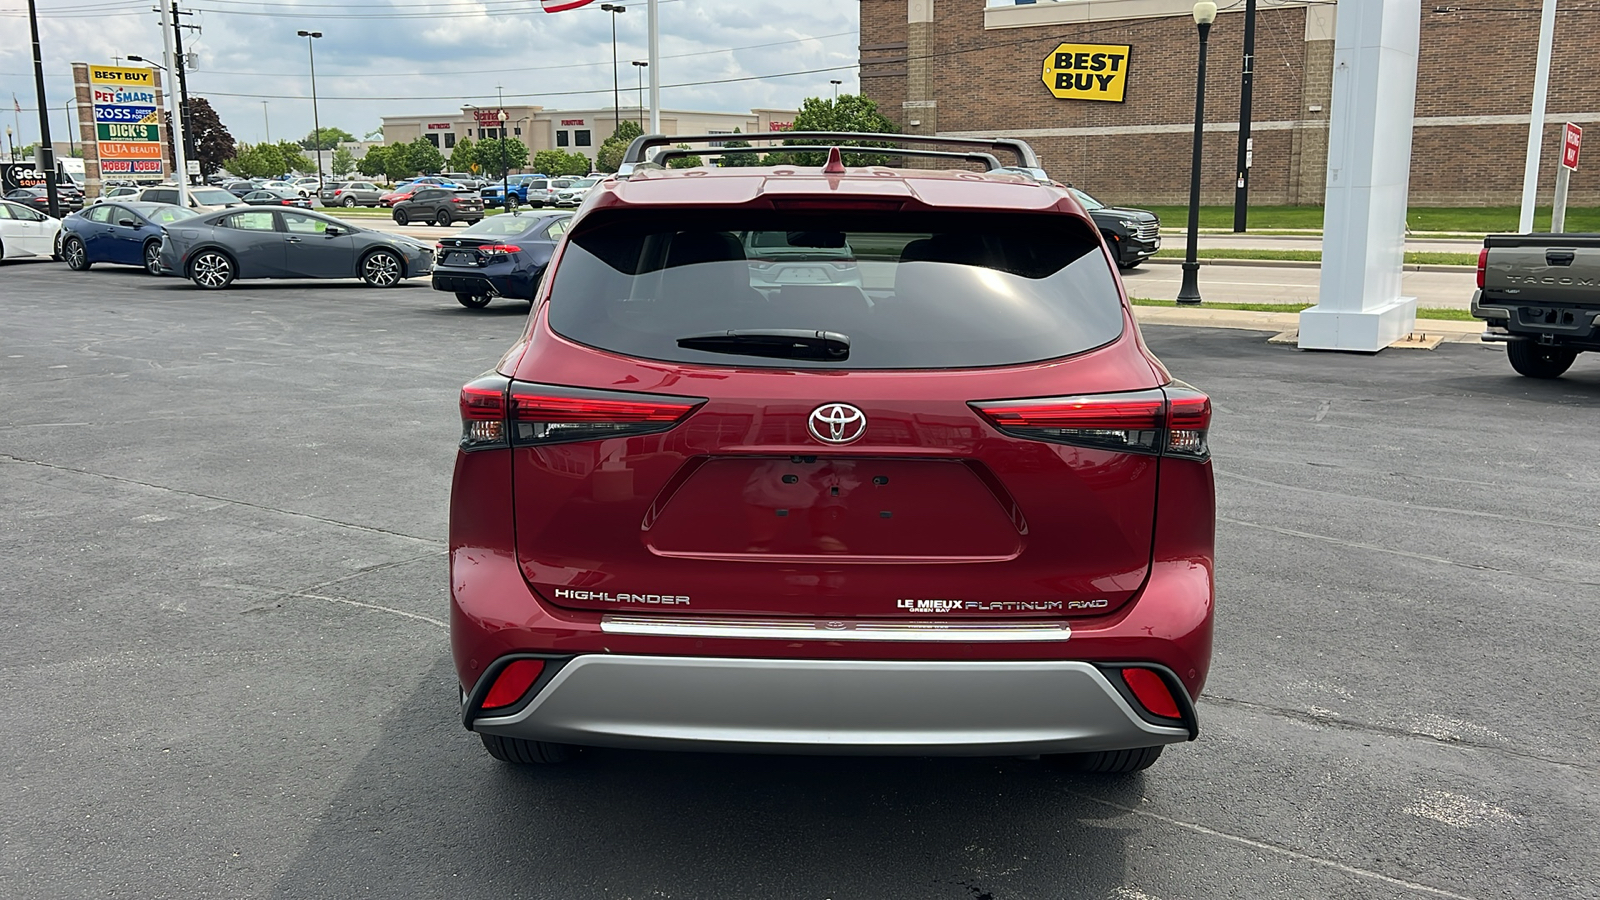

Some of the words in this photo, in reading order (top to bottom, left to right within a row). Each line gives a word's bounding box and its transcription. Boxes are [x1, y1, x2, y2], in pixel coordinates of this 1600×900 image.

[1054, 52, 1124, 72] BEST
[94, 71, 122, 80] BEST
[124, 72, 148, 81] BUY
[1055, 73, 1116, 92] BUY
[95, 107, 131, 119] ROSS
[108, 124, 148, 137] DICK'S
[1567, 130, 1580, 147] WRONG
[103, 143, 128, 154] ULTA
[130, 146, 160, 154] BEAUTY
[102, 161, 132, 173] HOBBY
[133, 161, 161, 173] LOBBY
[11, 167, 47, 180] Gee
[1506, 275, 1600, 287] TACOM
[554, 588, 691, 606] HIGHLANDER
[897, 599, 914, 609] LE
[917, 599, 963, 610] MIEUX
[965, 600, 1063, 611] PLATINUM
[1068, 599, 1109, 609] AWD
